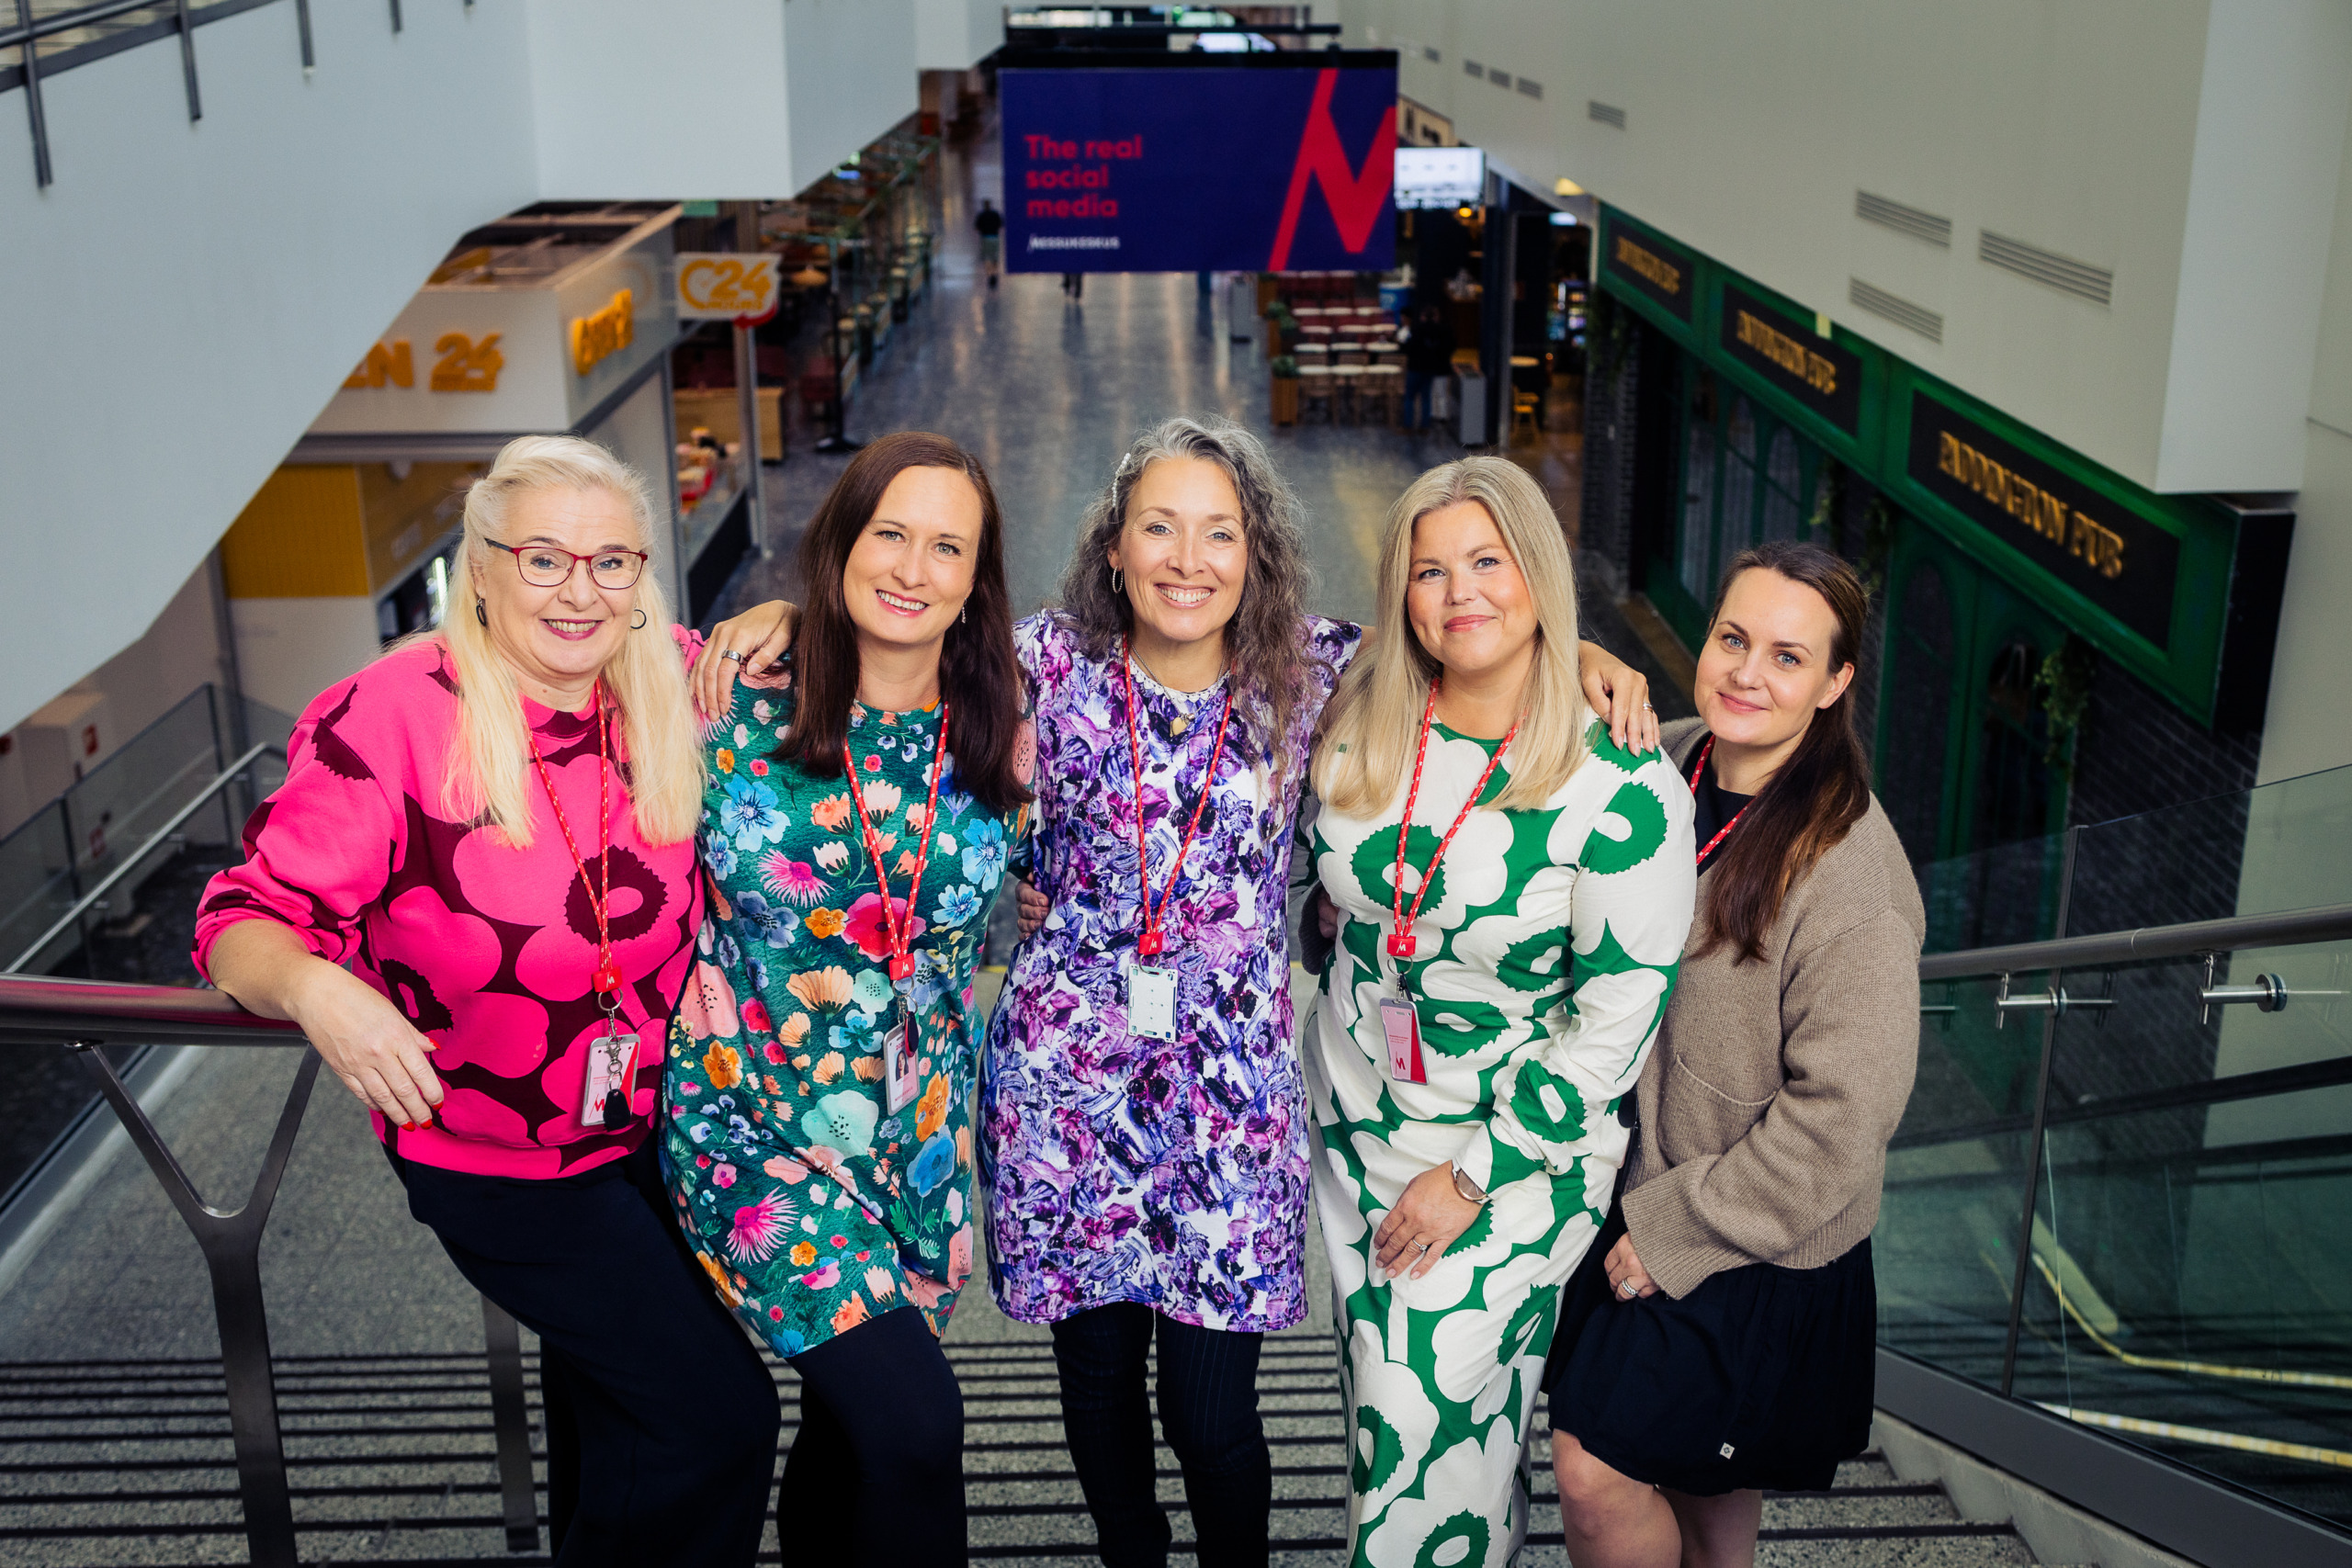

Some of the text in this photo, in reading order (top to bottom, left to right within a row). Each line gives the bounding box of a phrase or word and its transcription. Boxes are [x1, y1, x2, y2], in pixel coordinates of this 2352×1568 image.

[1024, 133, 1141, 158] The real
[1026, 164, 1108, 187] social
[1027, 193, 1118, 217] media
